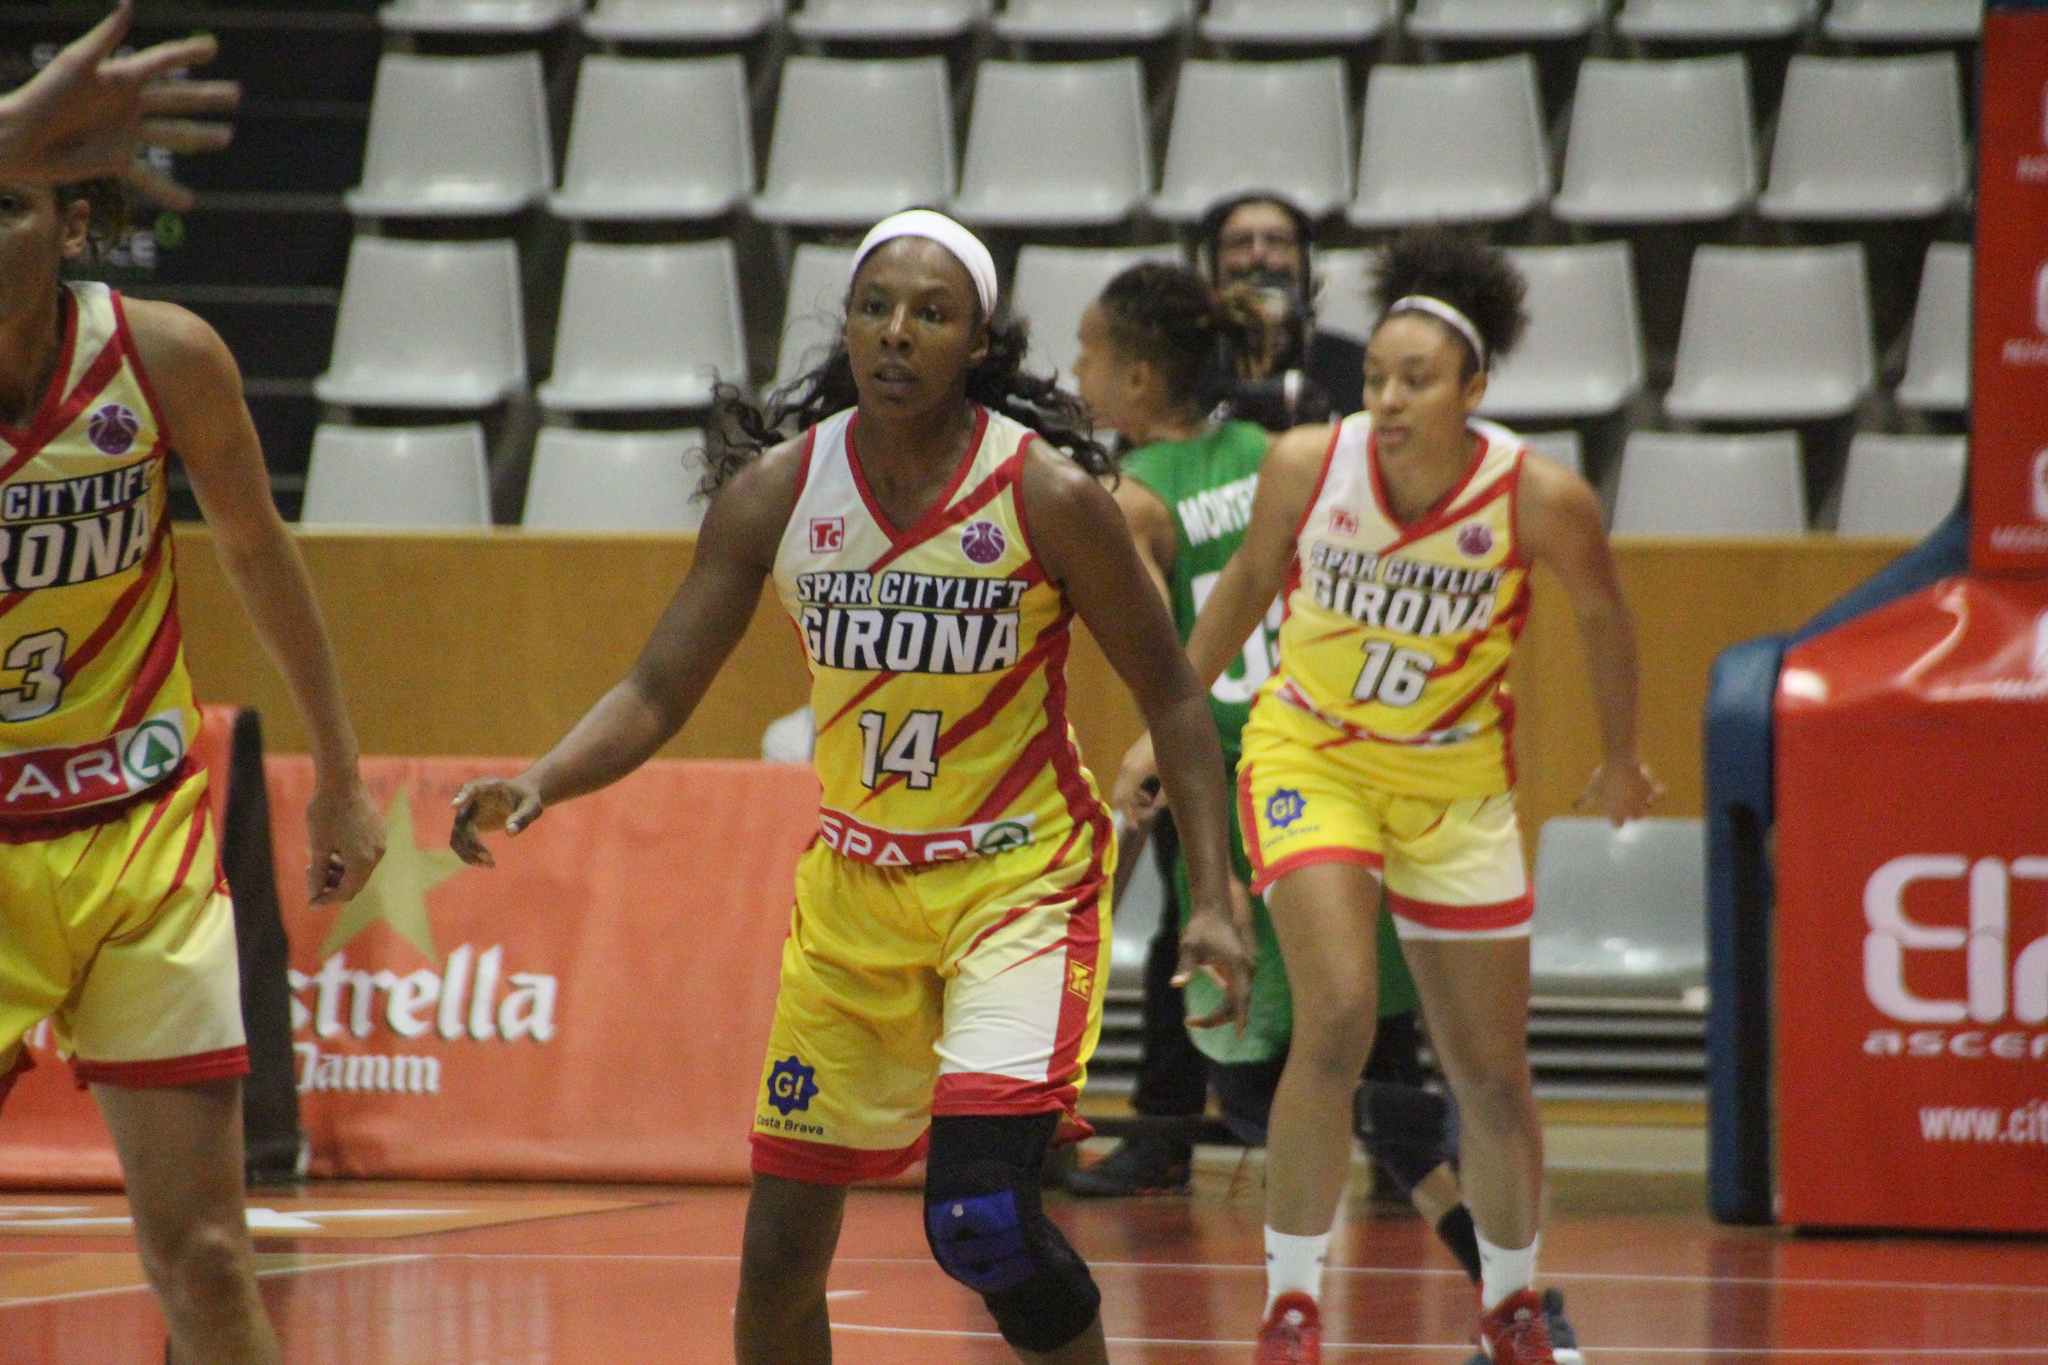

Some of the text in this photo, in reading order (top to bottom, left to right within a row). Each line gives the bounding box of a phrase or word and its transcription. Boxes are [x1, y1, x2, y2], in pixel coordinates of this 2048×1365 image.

[798, 571, 1029, 609] SPAR CITYLIFT
[1310, 541, 1503, 596] SPAR CITYLIFT
[1309, 566, 1496, 640] GIRONA
[801, 605, 1019, 674] GIRONA
[1352, 637, 1436, 708] 16
[858, 709, 943, 790] 14
[774, 1071, 805, 1100] G!
[756, 1114, 824, 1135] Costa Brava
